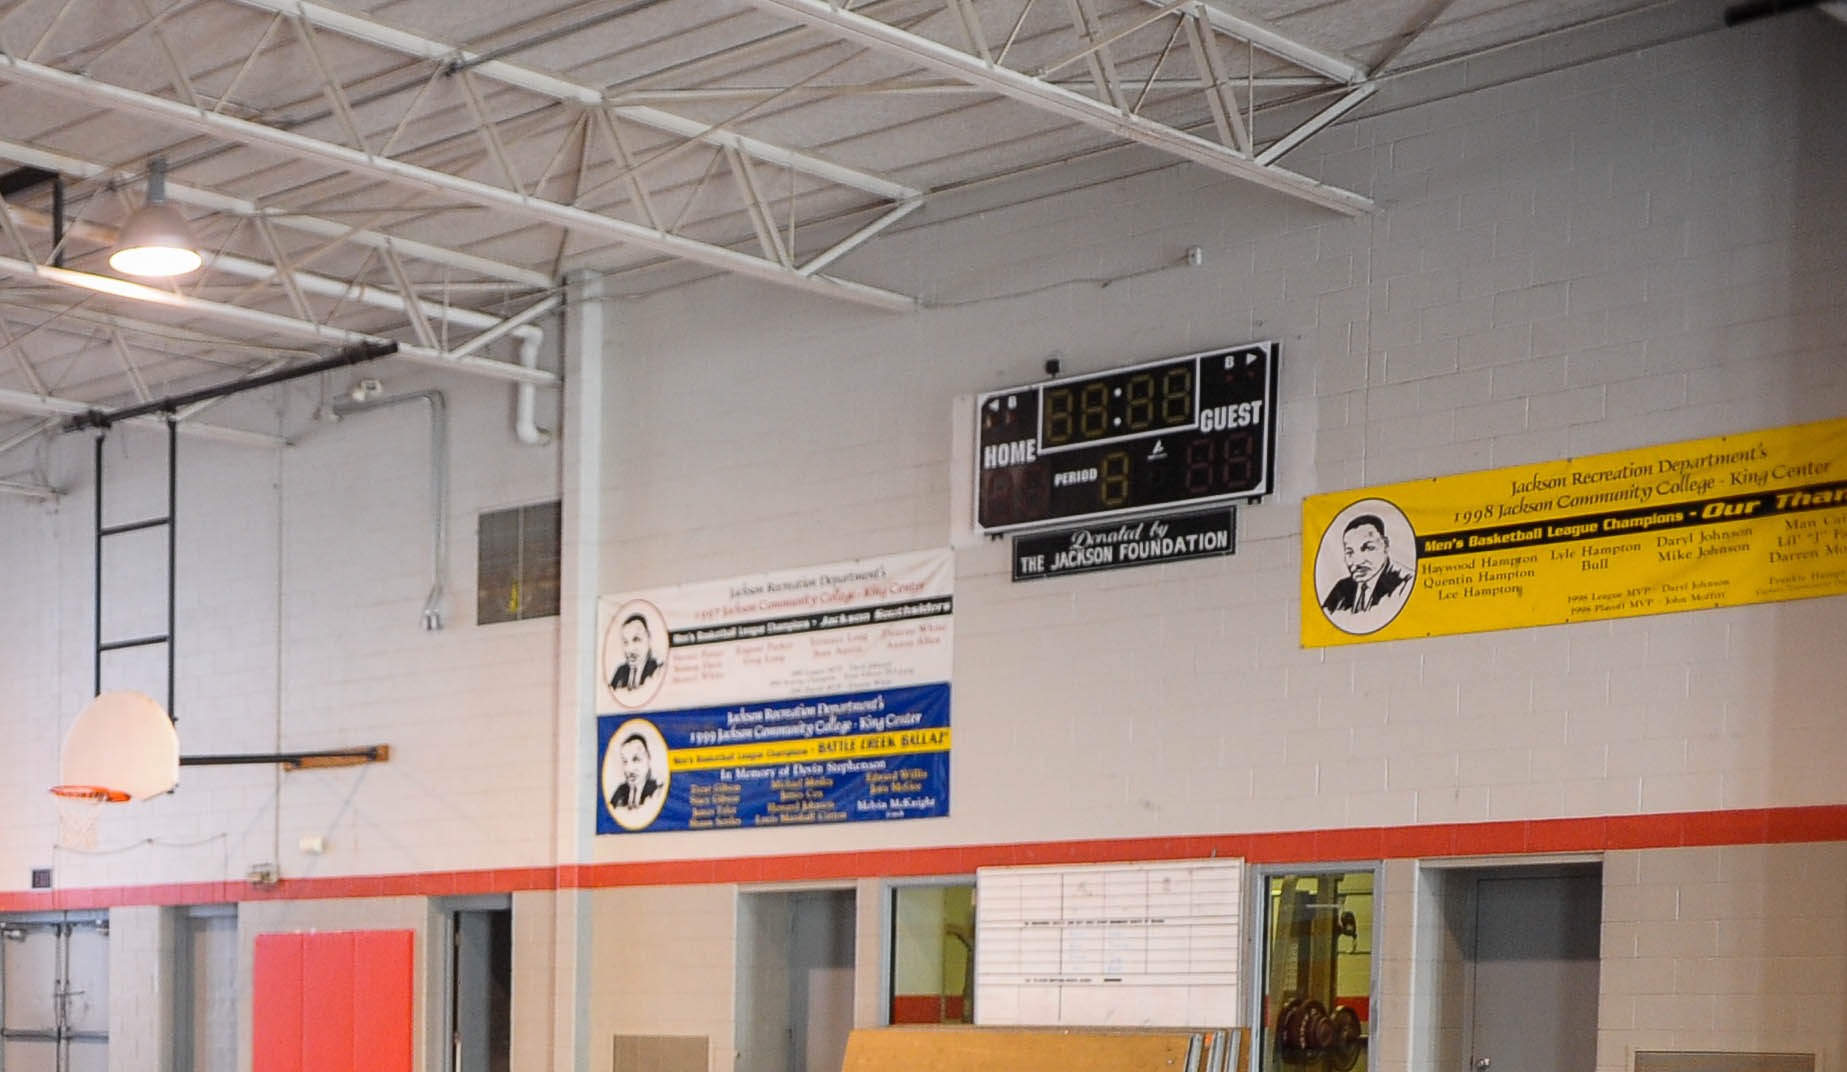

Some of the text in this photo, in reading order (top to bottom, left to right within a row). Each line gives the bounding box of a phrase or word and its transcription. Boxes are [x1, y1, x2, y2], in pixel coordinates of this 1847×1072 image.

[1200, 400, 1262, 432] GUEST
[984, 439, 1036, 469] HOME
[1054, 468, 1097, 487] PERIOD
[1511, 442, 1768, 496] Jackson Recreation Department's
[1454, 505, 1494, 525] 1998
[1498, 496, 1552, 518] Jackson
[1557, 481, 1652, 509] Community
[1656, 474, 1715, 496] College
[1731, 468, 1769, 487] King
[1772, 461, 1832, 480] Center
[1071, 520, 1169, 549] Donated by
[1425, 537, 1464, 553] Men's
[1469, 527, 1542, 547] Basketball
[1548, 522, 1598, 538] League
[1603, 511, 1684, 531] Champions
[1702, 500, 1761, 519] Our
[1657, 527, 1752, 548] Daryl Johnson
[1020, 531, 1228, 574] THE JACKSON FOUNDATION
[1582, 541, 1641, 558] Hampton
[1658, 543, 1750, 562] Mike Johnson
[1769, 550, 1818, 563] Darren
[1422, 554, 1538, 575] Haywood Hampton
[729, 582, 764, 600] Jackson
[767, 578, 816, 593] Recreation
[1424, 569, 1534, 588] Quentin Hampton
[1627, 586, 1651, 598] MVP
[1692, 579, 1730, 590] Johnson
[723, 602, 756, 617] Jackson
[759, 595, 816, 611] Community
[820, 587, 855, 603] College
[864, 584, 888, 599] King
[889, 582, 925, 594] Center
[1438, 584, 1520, 600] Lee Hampton
[1630, 599, 1654, 609] MVP
[737, 624, 766, 638] League
[820, 613, 871, 627] Jackson
[727, 694, 885, 726] Jackson Recreation Department's
[689, 731, 717, 745] 1999
[717, 722, 753, 744] Jackson
[754, 720, 814, 739] Community
[815, 714, 852, 735] College
[859, 714, 885, 732] King
[885, 713, 922, 728] Center
[818, 741, 855, 754] BATTLE
[861, 738, 896, 750] CREEK
[720, 759, 886, 781] In Memory of Devin Stephenson
